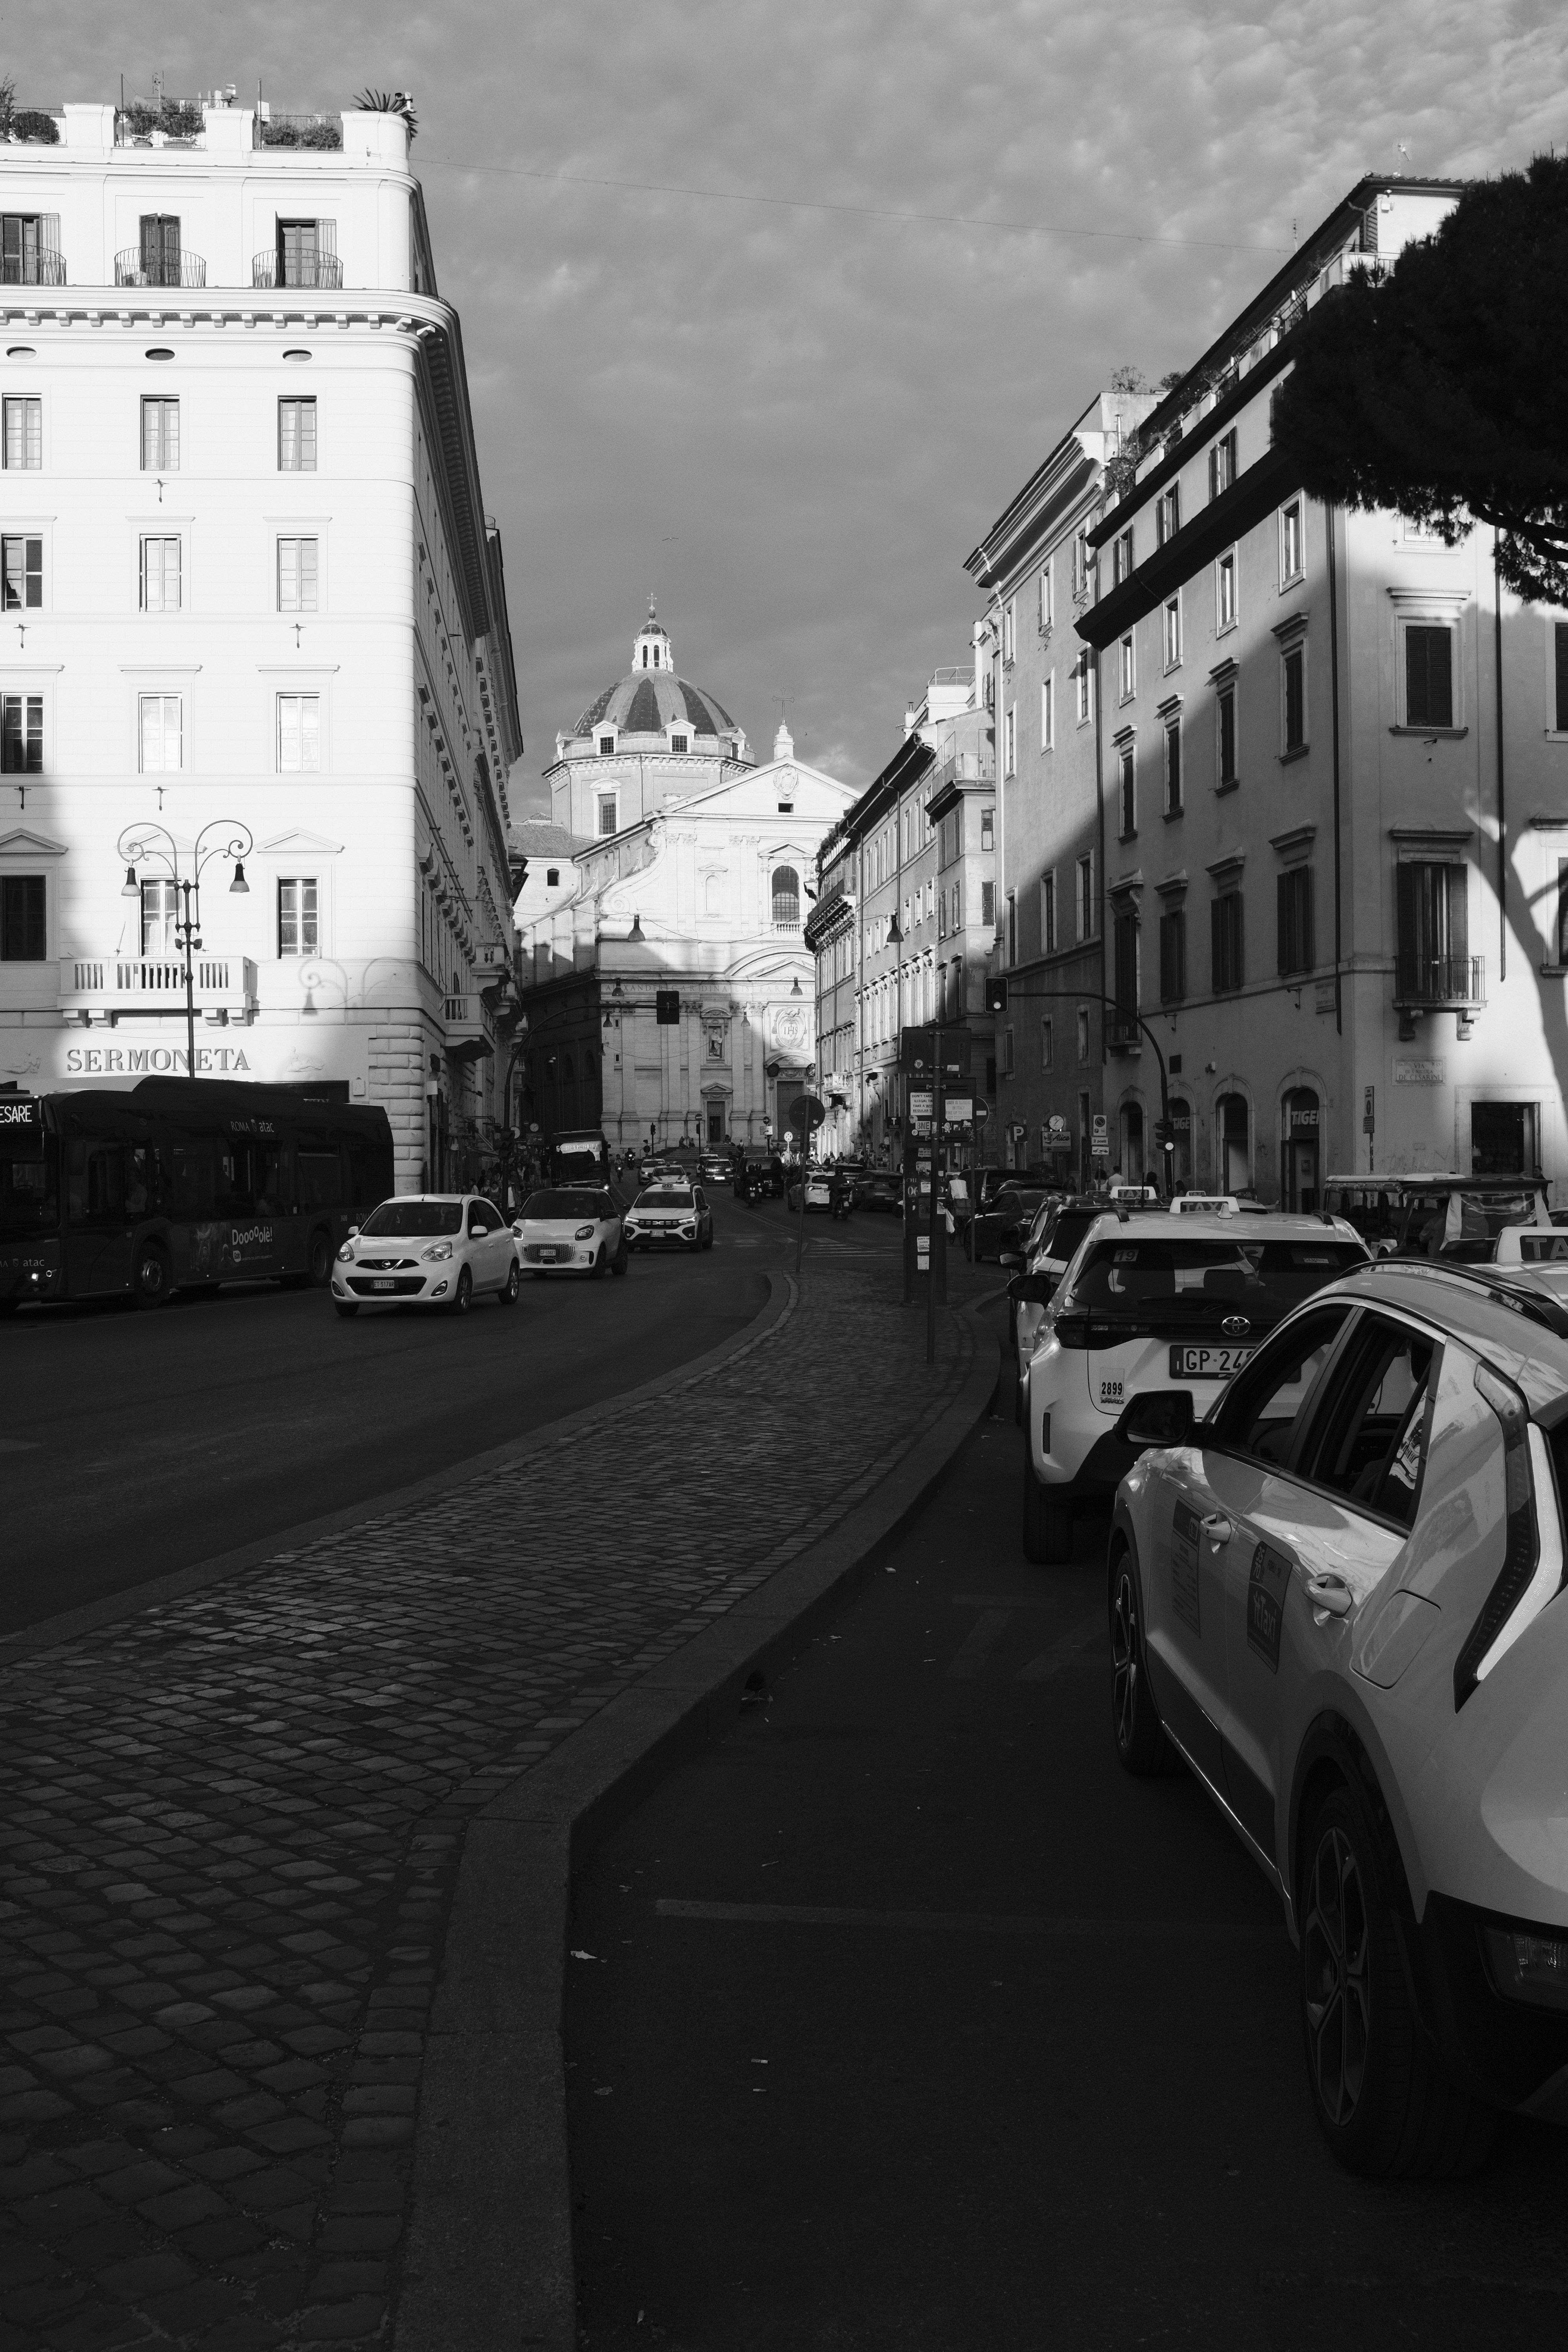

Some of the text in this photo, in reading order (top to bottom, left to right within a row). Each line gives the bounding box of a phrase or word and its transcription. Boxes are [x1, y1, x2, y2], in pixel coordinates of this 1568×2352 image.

[784, 1026, 798, 1034] IHS
[67, 1049, 251, 1072] SERMONETA
[230, 1120, 274, 1132] ROMA atac
[1182, 1202, 1227, 1212] TAX
[1117, 1250, 1136, 1261] 19
[23, 1259, 45, 1267] atac
[1186, 1350, 1210, 1371] GP
[1101, 1382, 1122, 1396] 2899
[1255, 1546, 1265, 1564] 35
